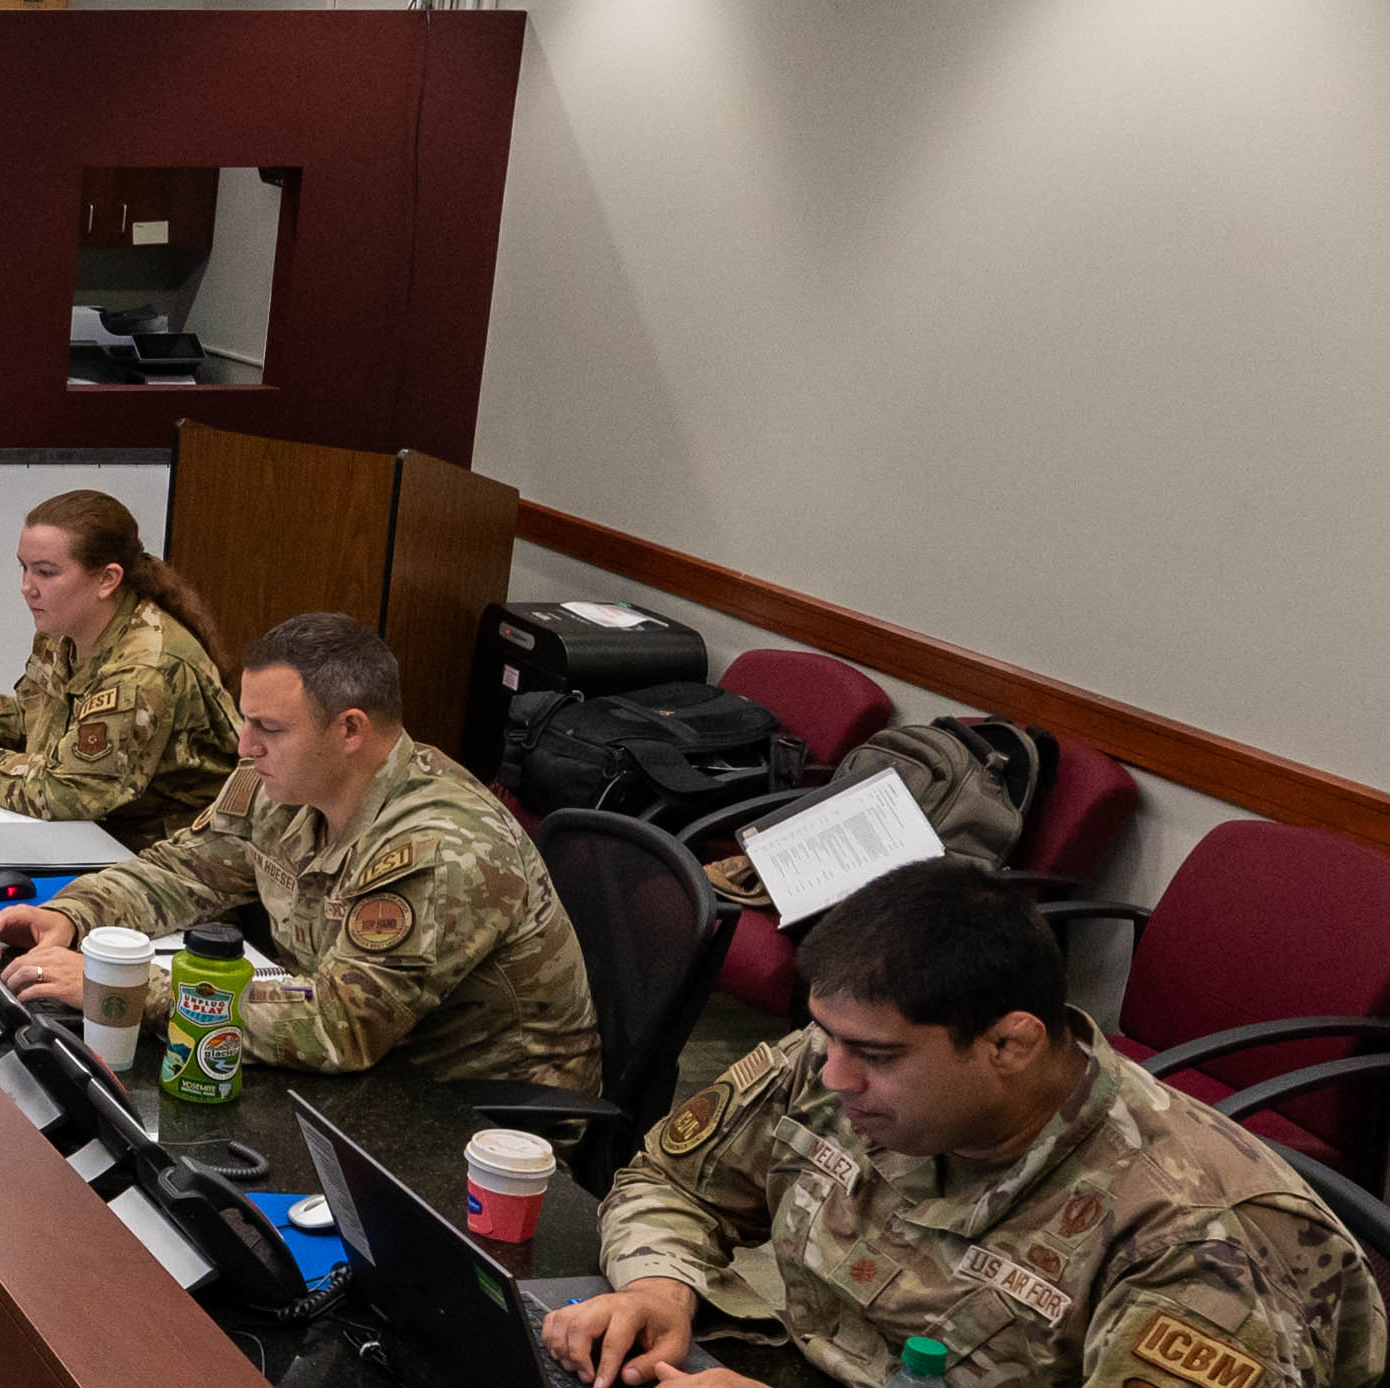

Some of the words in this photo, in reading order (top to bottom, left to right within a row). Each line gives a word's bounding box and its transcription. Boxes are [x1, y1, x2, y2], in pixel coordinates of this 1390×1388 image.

[82, 692, 113, 714] TEST
[264, 856, 296, 892] HOESE
[184, 994, 225, 1008] UNPLUG
[192, 1004, 224, 1014] PLAY
[809, 1139, 853, 1182] VELEZ
[1001, 1269, 1030, 1295] AIR
[1025, 1283, 1061, 1318] FOR
